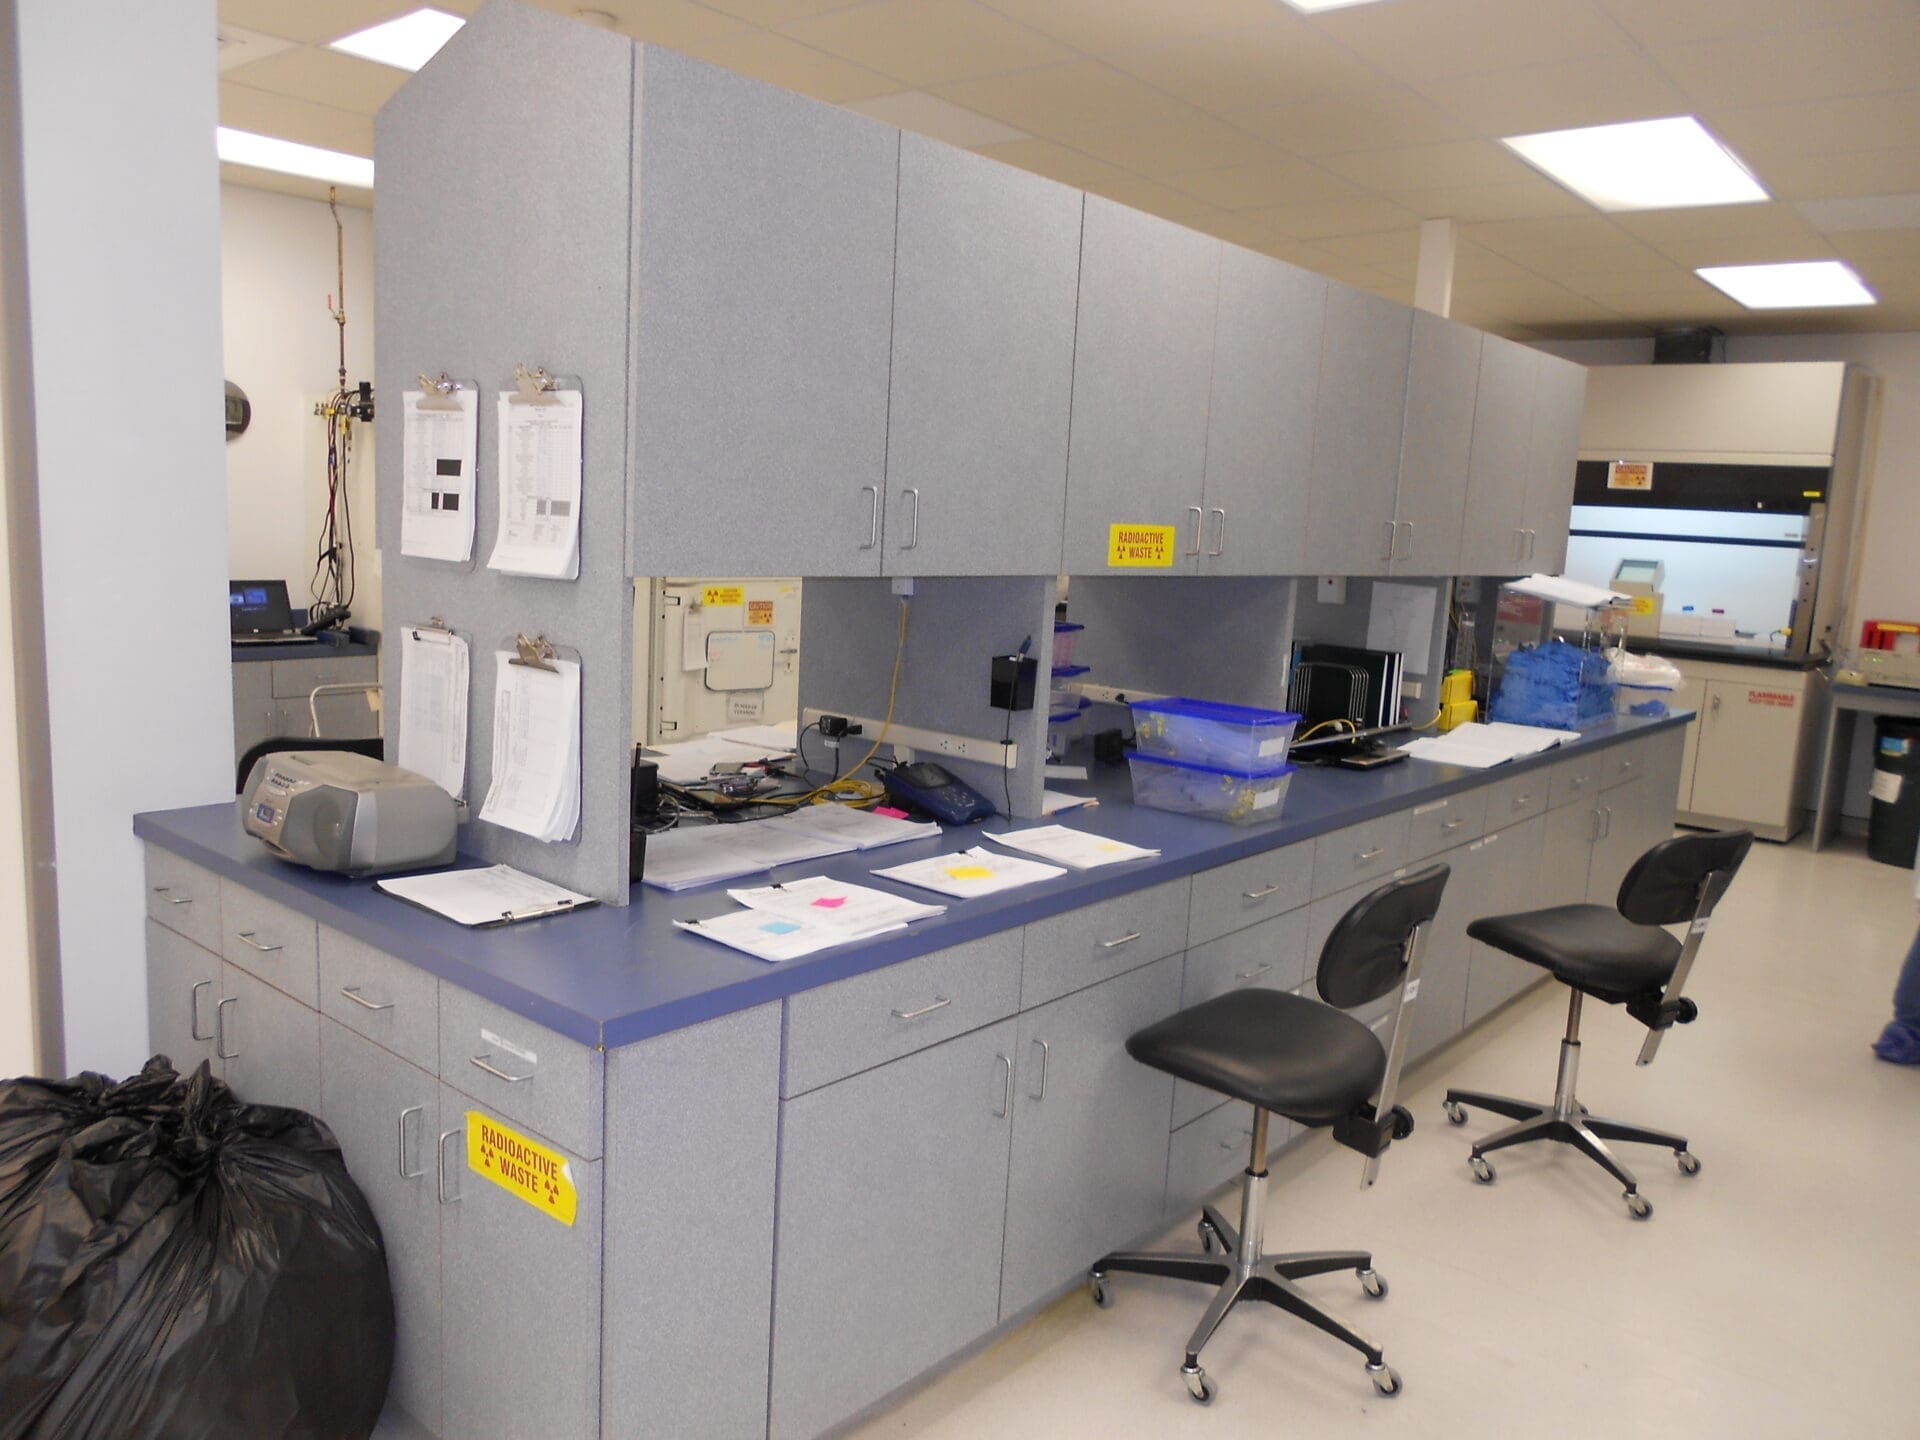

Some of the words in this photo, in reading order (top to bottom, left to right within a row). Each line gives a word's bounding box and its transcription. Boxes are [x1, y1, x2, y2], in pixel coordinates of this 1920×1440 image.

[1118, 532, 1164, 544] RADIOACTIVE
[1129, 546, 1152, 558] WASTE
[481, 1124, 558, 1181] RADIOACTIVE
[499, 1155, 538, 1194] WASTE
